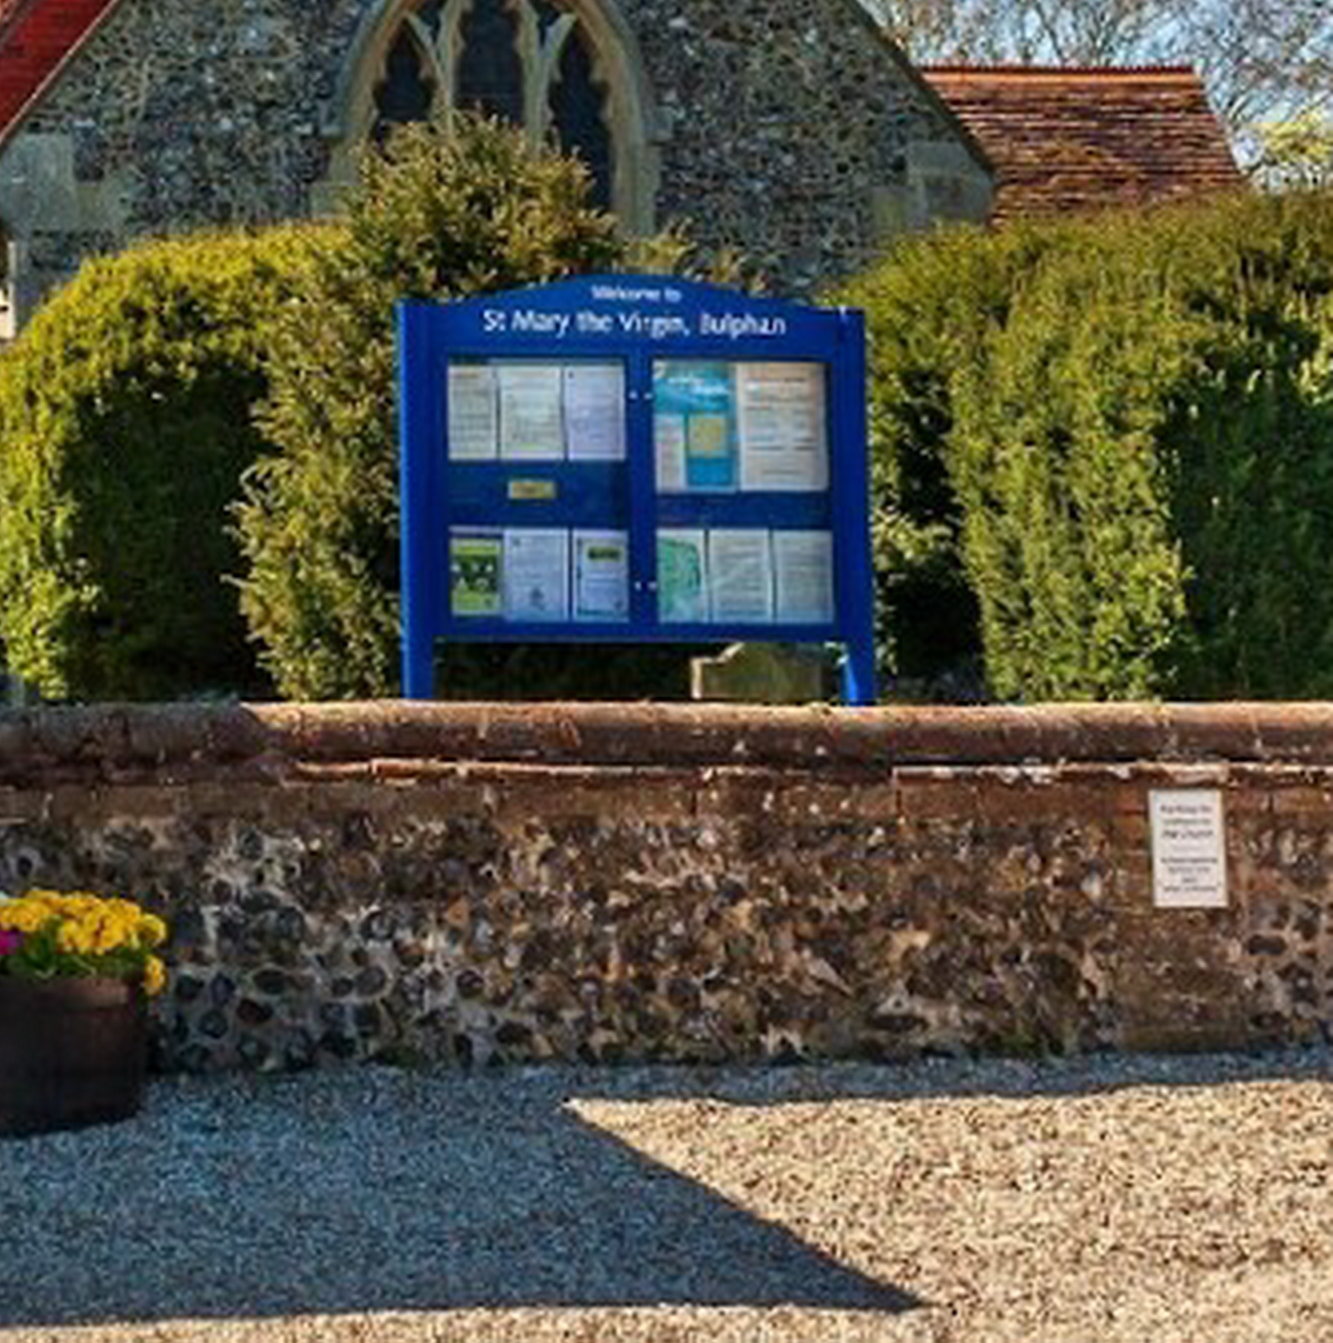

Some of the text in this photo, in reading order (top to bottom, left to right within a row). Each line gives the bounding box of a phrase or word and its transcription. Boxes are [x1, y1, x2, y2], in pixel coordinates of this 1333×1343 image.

[664, 286, 683, 303] to
[483, 309, 507, 332] St
[511, 309, 570, 339] Mary
[576, 310, 614, 334] the
